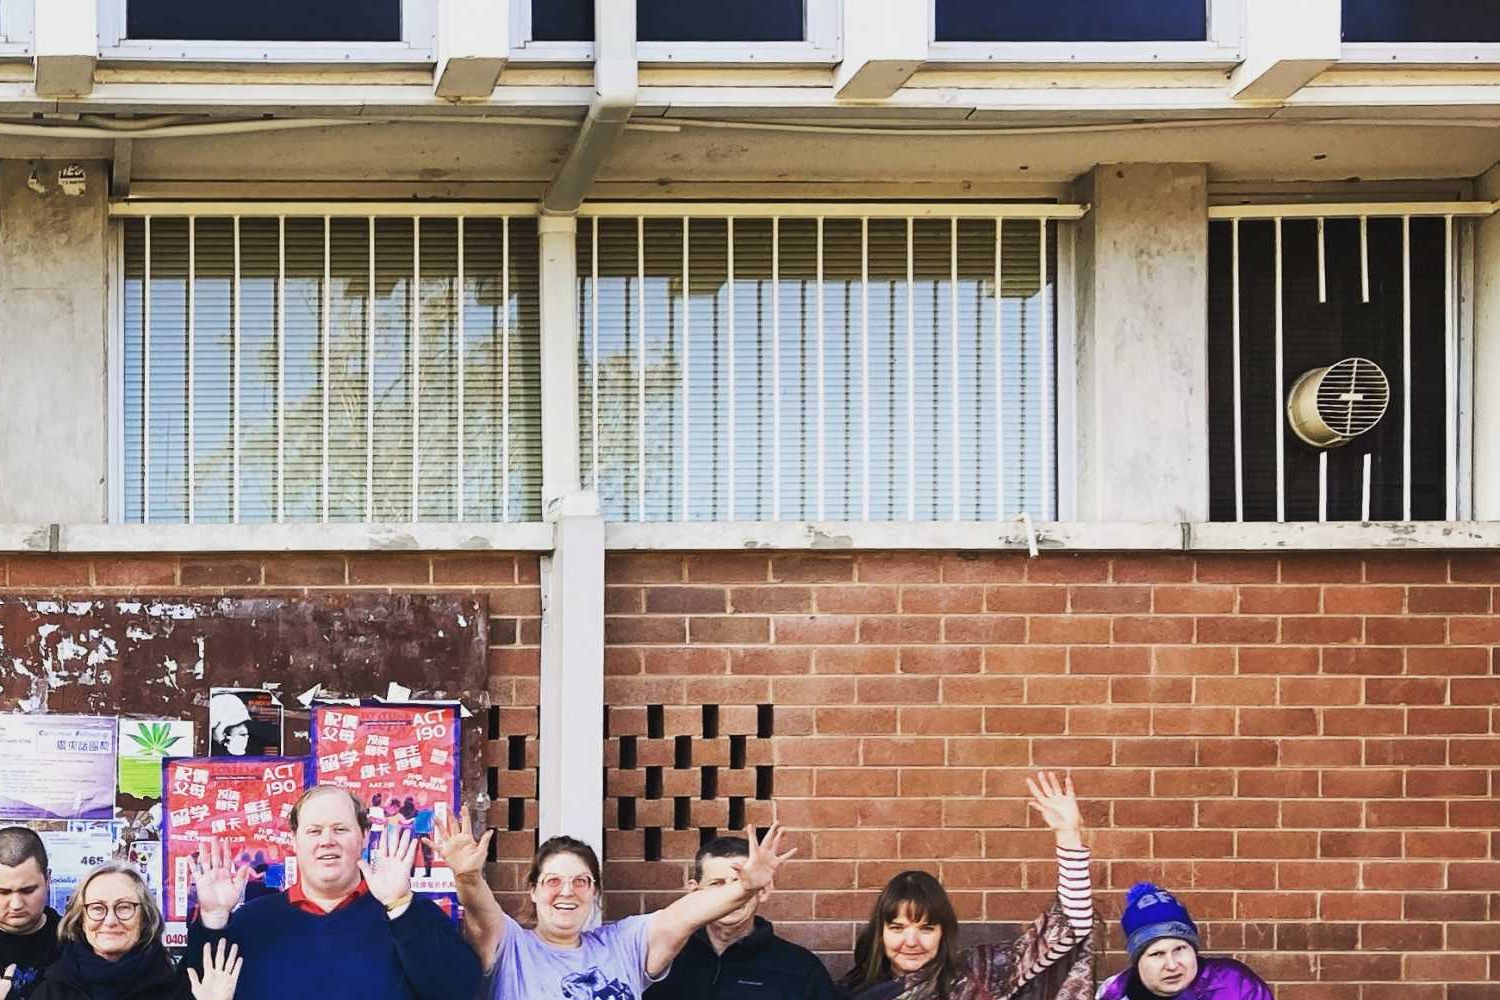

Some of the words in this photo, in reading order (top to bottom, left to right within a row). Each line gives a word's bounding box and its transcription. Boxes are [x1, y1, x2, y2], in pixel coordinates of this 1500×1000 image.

[412, 709, 446, 726] ACT
[416, 725, 446, 741] 190
[263, 764, 295, 780] ACT
[266, 780, 296, 796] 190
